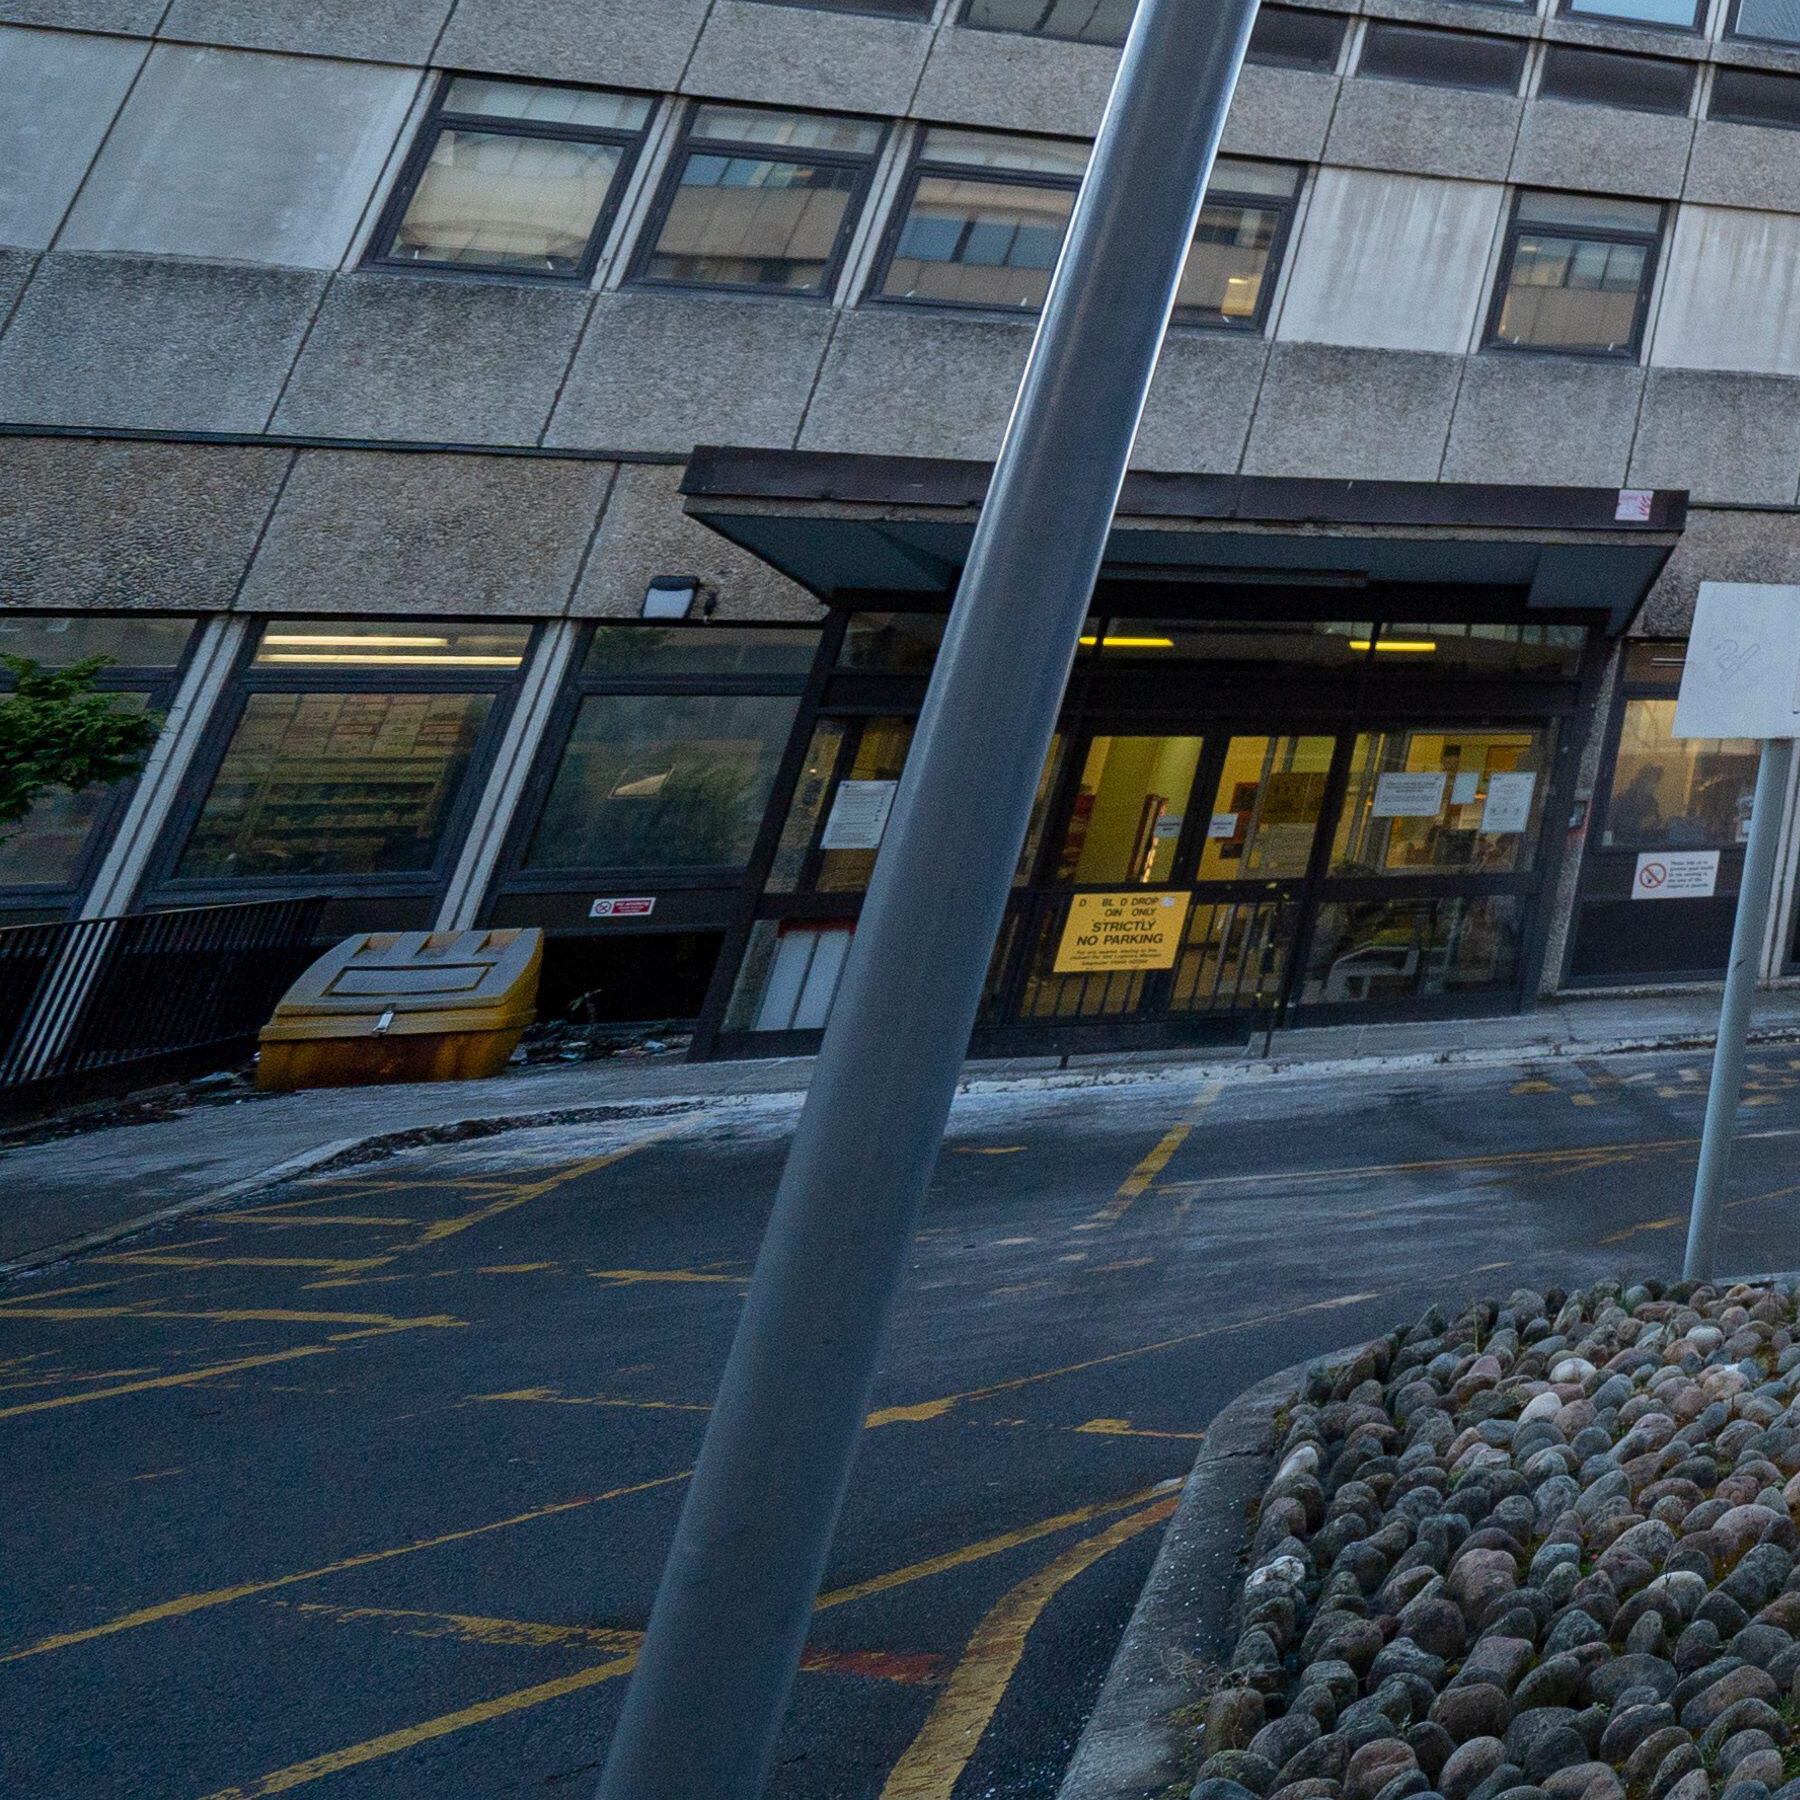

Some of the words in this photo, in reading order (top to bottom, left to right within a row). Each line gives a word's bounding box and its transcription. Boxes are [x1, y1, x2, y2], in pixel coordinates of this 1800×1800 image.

[1131, 896, 1160, 906] DROP
[1131, 907, 1158, 917] ONLY
[1091, 920, 1157, 933] STRICTLY
[1076, 935, 1099, 947] NO
[1103, 933, 1164, 946] PARKING
